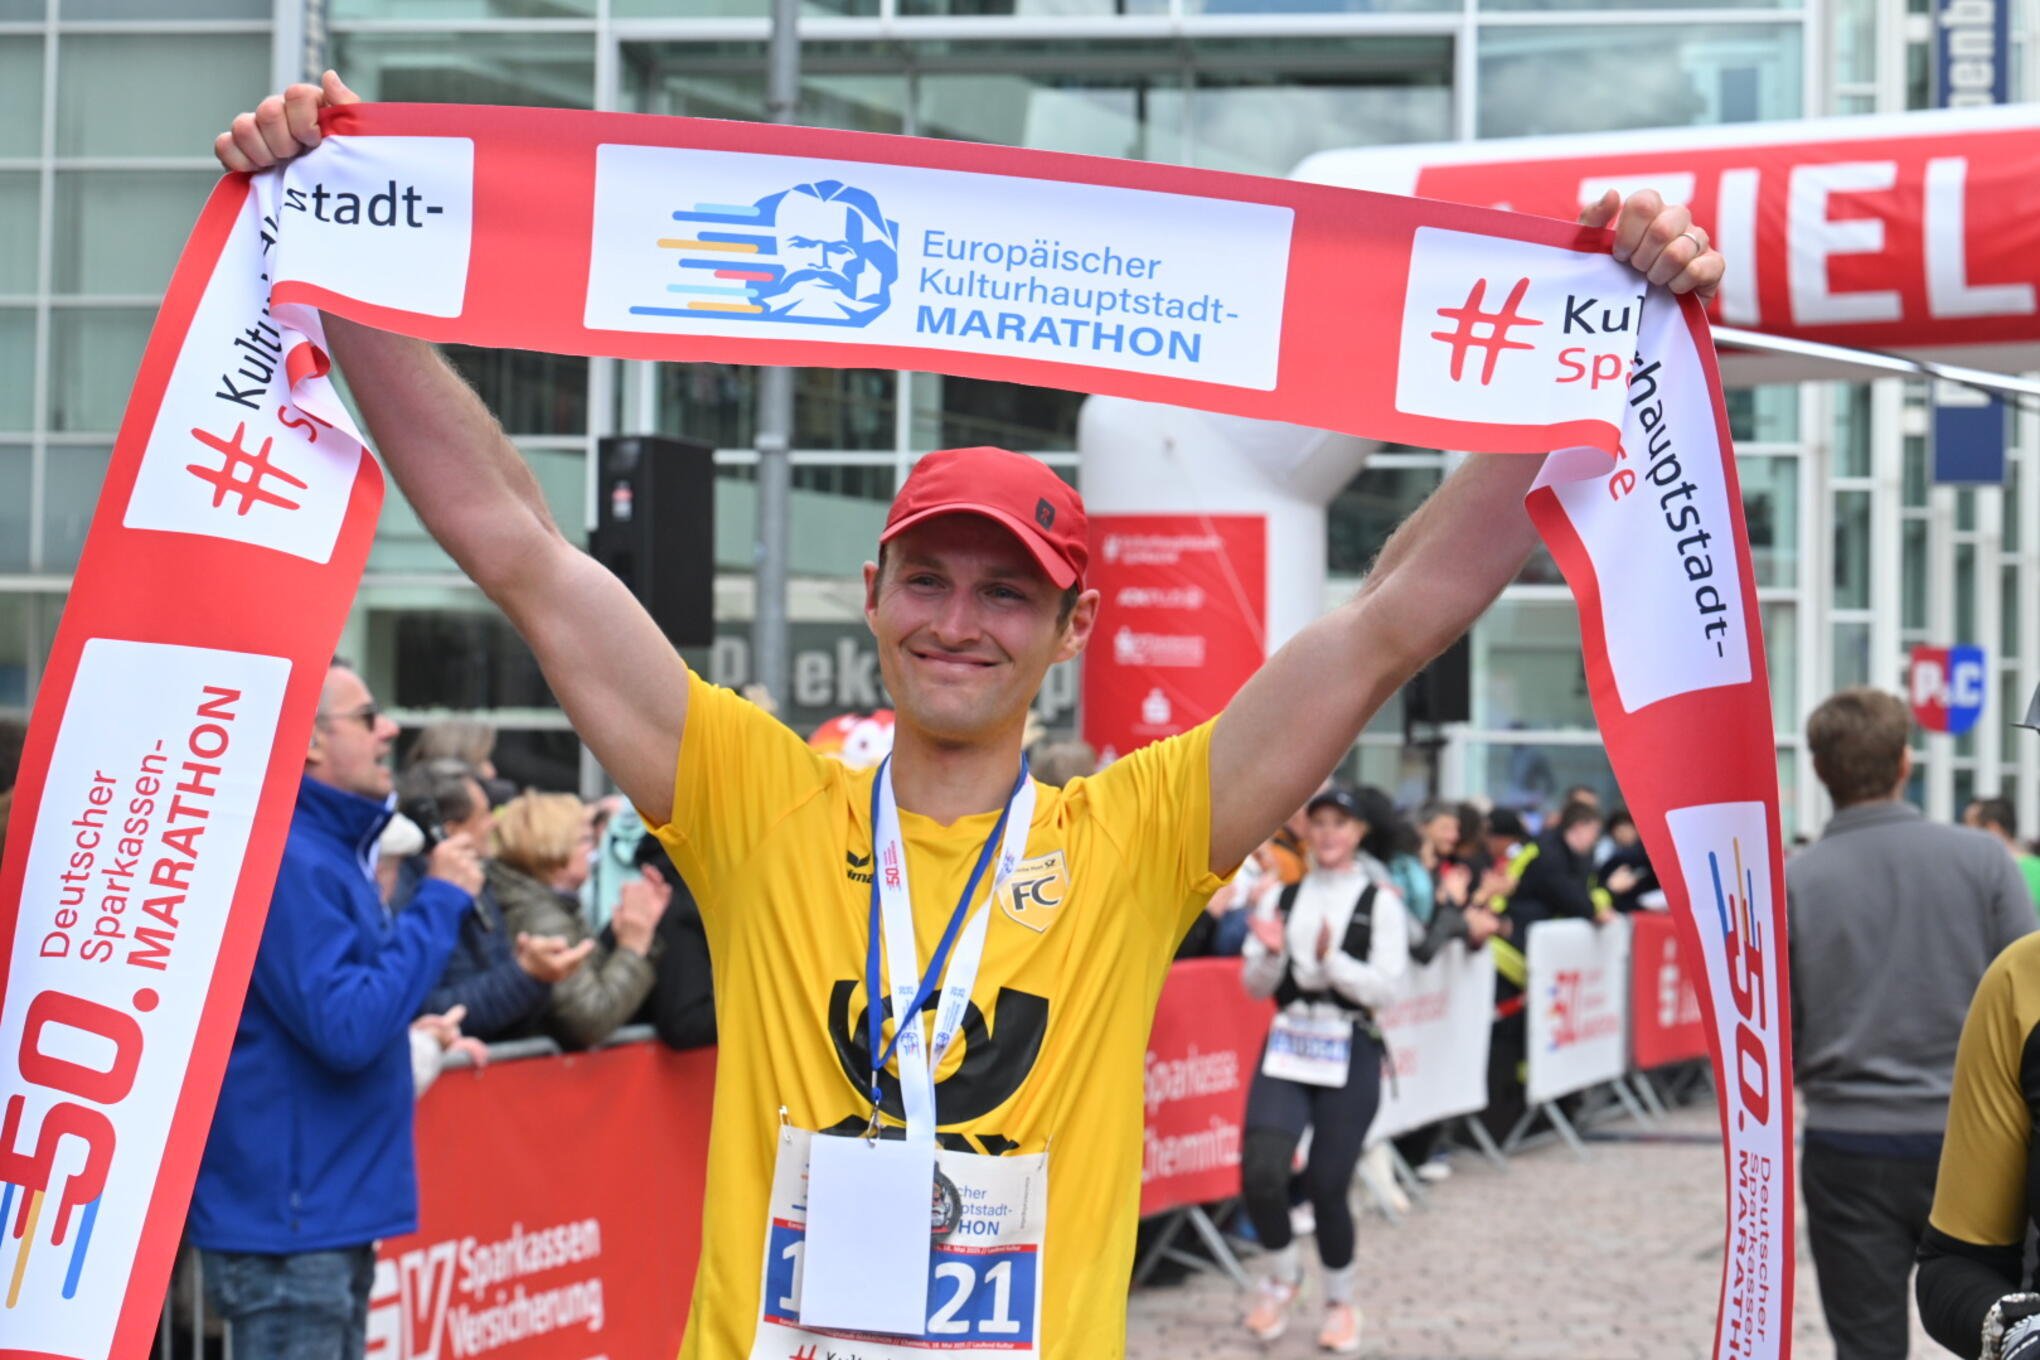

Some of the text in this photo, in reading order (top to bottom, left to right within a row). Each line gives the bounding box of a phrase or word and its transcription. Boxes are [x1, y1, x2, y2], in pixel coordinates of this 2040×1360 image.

[919, 266, 1239, 324] Kulturhauptstadt-
[922, 229, 1162, 279] Europäischer
[1577, 156, 2036, 328] IEL
[916, 304, 1202, 363] MARATHON
[39, 769, 117, 958] Deutscher
[79, 739, 168, 964] Sparkassen-
[126, 685, 242, 972] MARATHON
[1011, 875, 1060, 911] FC
[458, 1218, 601, 1302] Sparkassen
[1728, 1149, 1749, 1360] MARATH
[1757, 1155, 1772, 1344] Deutscher
[448, 1277, 604, 1359] Versicherung
